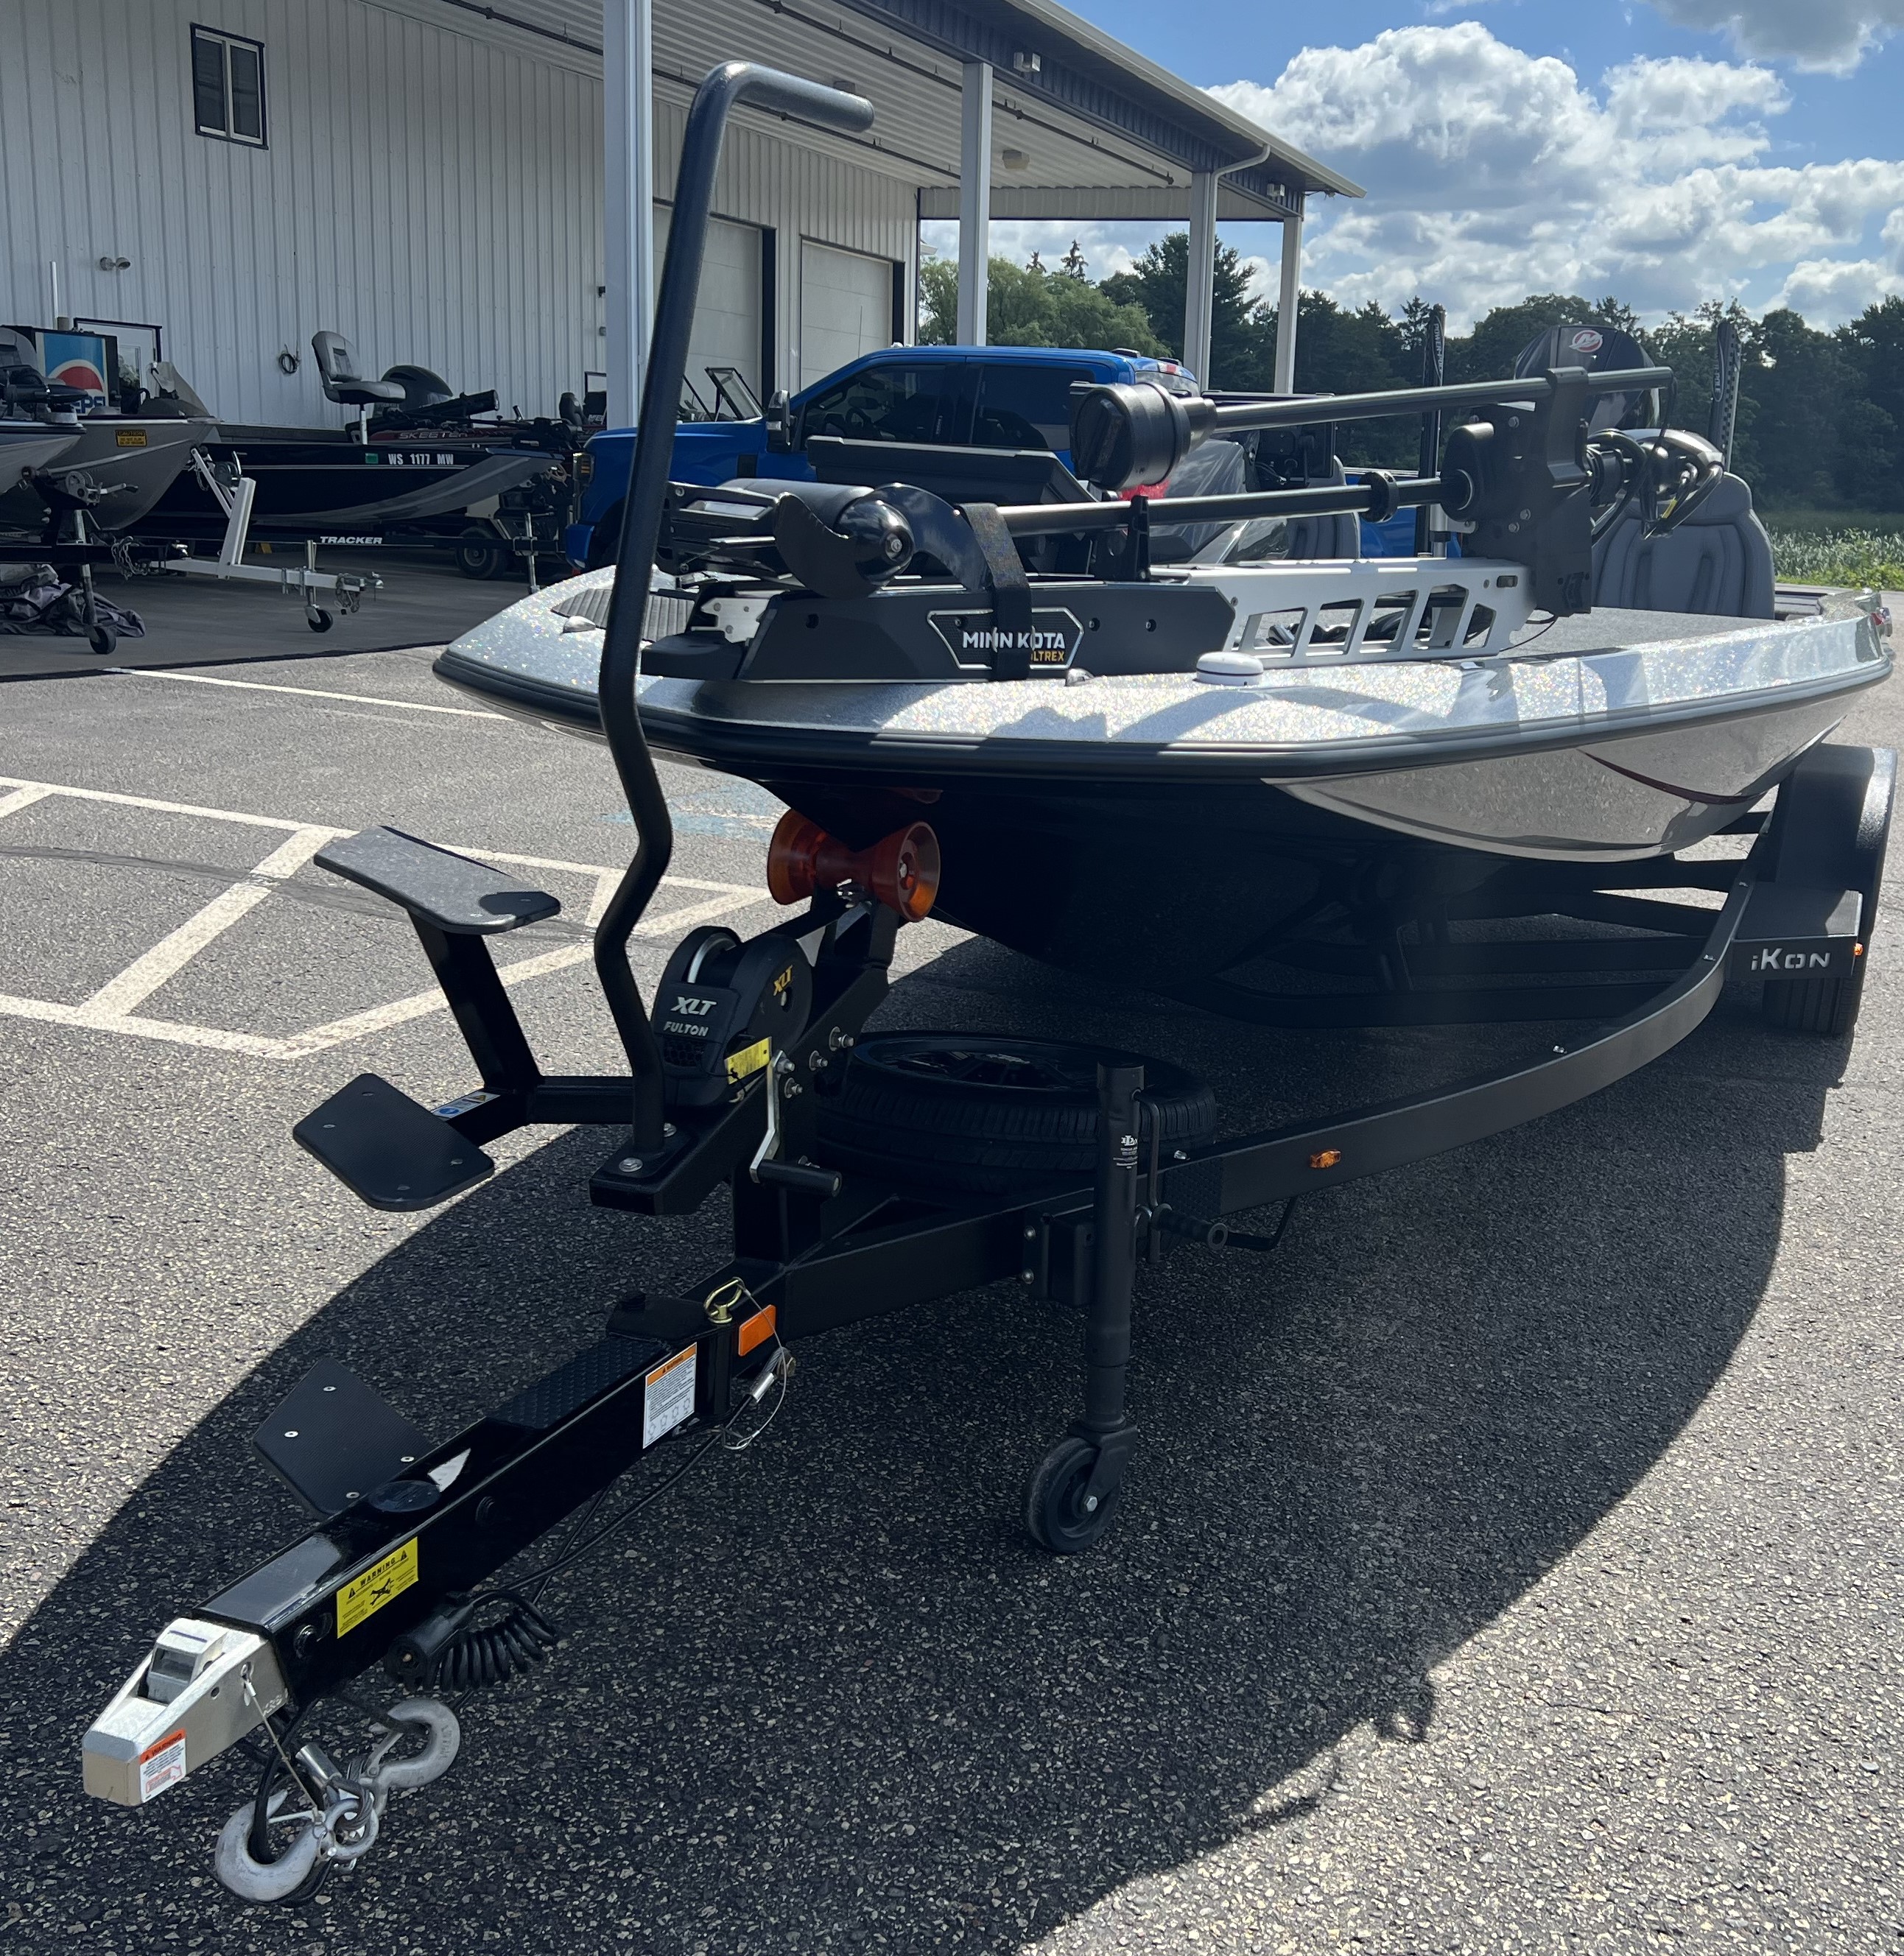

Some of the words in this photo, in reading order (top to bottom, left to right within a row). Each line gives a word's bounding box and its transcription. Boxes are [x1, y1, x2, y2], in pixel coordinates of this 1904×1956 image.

[398, 431, 468, 439] SKEETER
[388, 453, 404, 465] WS
[410, 453, 430, 465] 1177
[437, 453, 454, 465] MW
[320, 536, 382, 544] TRACKER
[963, 631, 1014, 649] MINN
[1017, 632, 1066, 649] KOTA
[773, 964, 793, 996] XLT
[670, 996, 717, 1016] XLT
[664, 1021, 709, 1037] FULTON
[360, 1557, 396, 1587] WARNING
